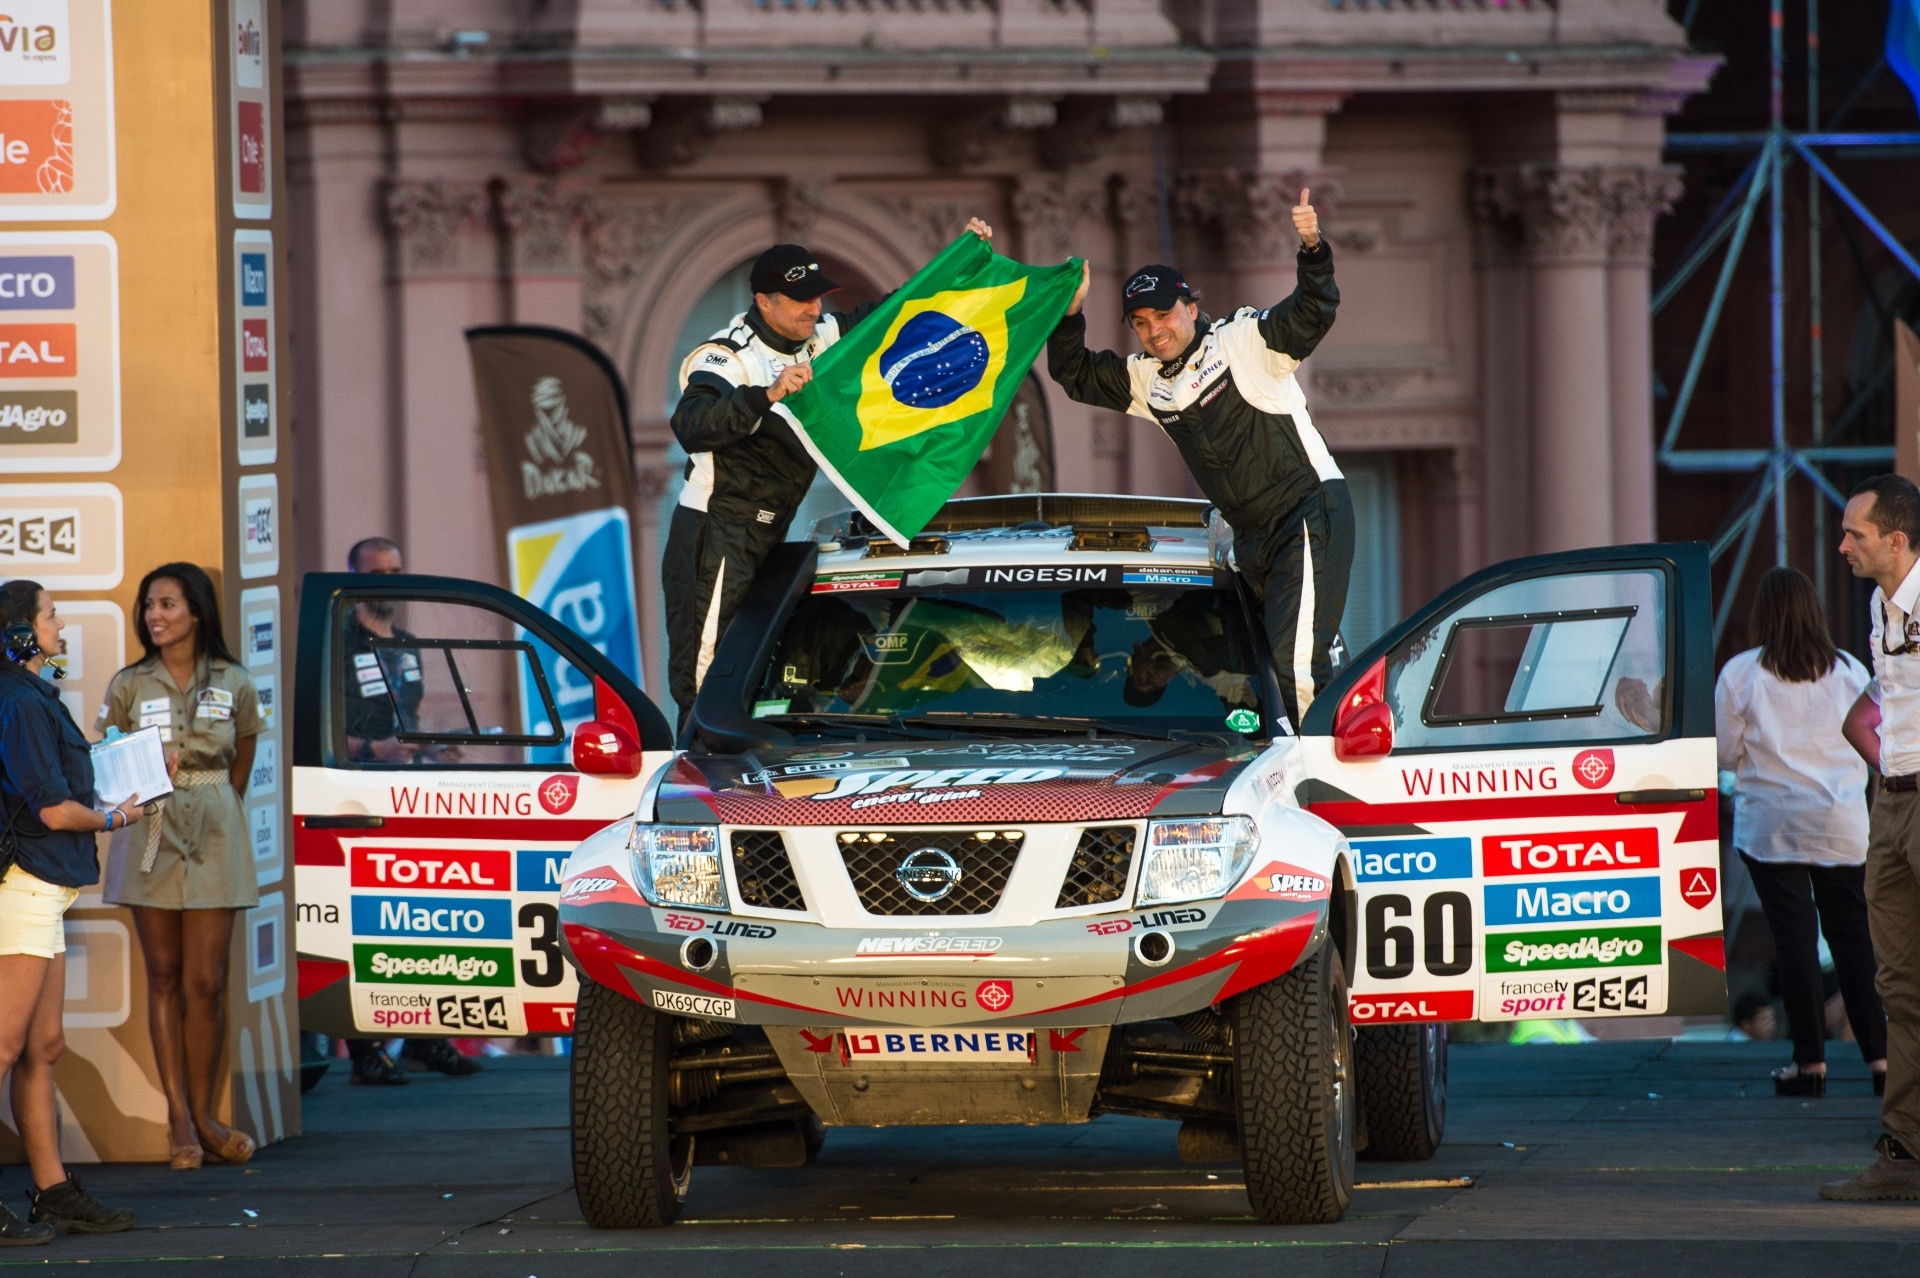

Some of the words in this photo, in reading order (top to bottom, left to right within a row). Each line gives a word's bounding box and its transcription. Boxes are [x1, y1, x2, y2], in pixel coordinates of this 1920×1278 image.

[705, 354, 730, 365] OMP
[756, 512, 775, 522] OMP
[984, 568, 1107, 583] INGESIM
[1138, 567, 1199, 575] dakar.com
[1145, 574, 1192, 583] Macro
[831, 582, 880, 590] TOTAL
[875, 636, 908, 649] OMP
[811, 768, 1065, 800] SPEED
[1401, 767, 1557, 796] WINNING
[390, 786, 531, 816] WINNING
[851, 791, 924, 810] energy
[919, 788, 982, 803] drink
[1500, 839, 1640, 869] TOTAL
[367, 853, 494, 885] TOTAL
[1267, 873, 1326, 893] SPEED
[1515, 887, 1631, 918] Macro
[380, 901, 484, 933] Macro
[664, 913, 777, 939] RED-LINED
[1086, 908, 1206, 936] RED-LINED
[1503, 936, 1644, 966] SpeedAgro
[370, 952, 498, 981] SpeedAgro
[836, 986, 967, 1008] WINNING
[1500, 979, 1568, 996] francetv
[369, 991, 432, 1007] francetv
[655, 991, 732, 1016] DK69CZGP
[1500, 992, 1566, 1016] sport
[373, 1008, 432, 1028] sport
[885, 1033, 1027, 1053] BERNER
